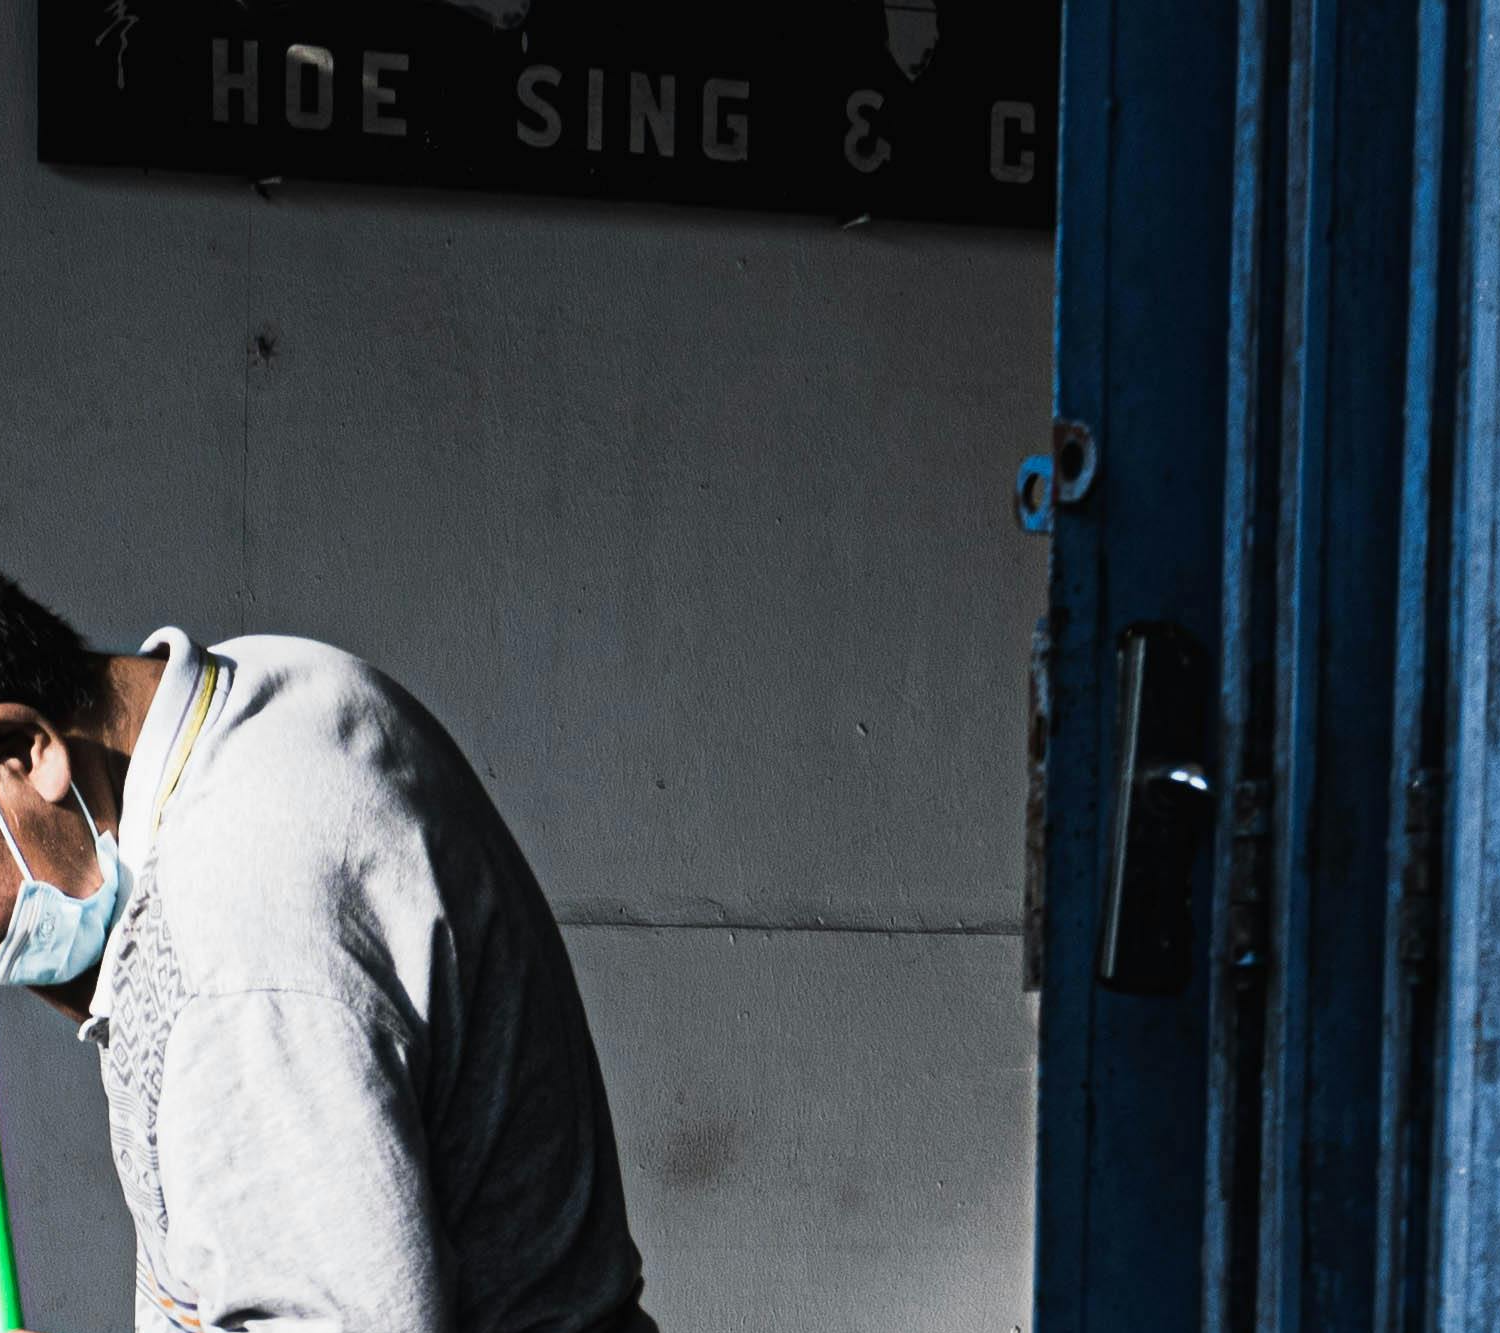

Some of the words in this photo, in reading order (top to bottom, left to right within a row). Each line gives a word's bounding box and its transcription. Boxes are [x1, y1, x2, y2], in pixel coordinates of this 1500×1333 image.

[211, 38, 410, 137] HOE
[516, 64, 750, 162] SING
[844, 89, 893, 173] &
